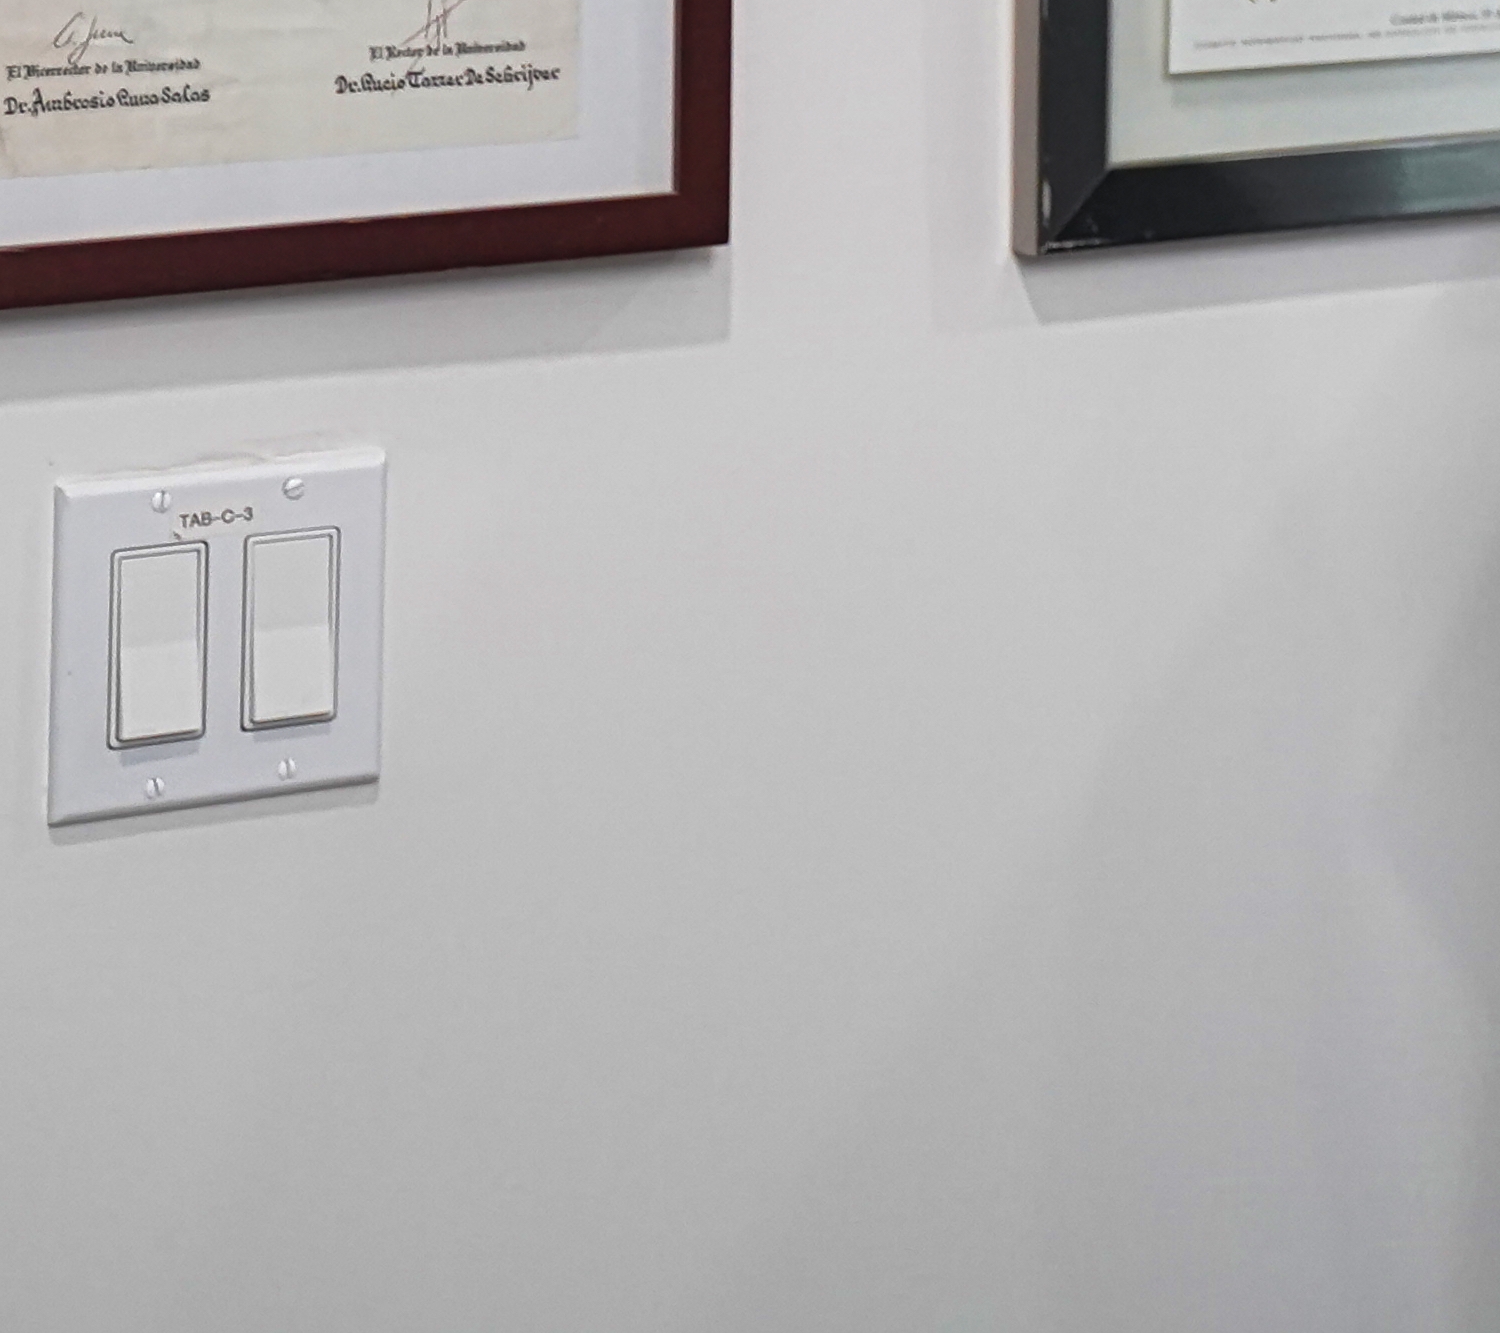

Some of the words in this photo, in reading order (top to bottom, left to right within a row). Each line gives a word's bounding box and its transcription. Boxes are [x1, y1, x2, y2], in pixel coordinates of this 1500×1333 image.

[95, 62, 108, 73] de
[111, 61, 122, 73] la
[179, 507, 254, 528] TAB-C-3
